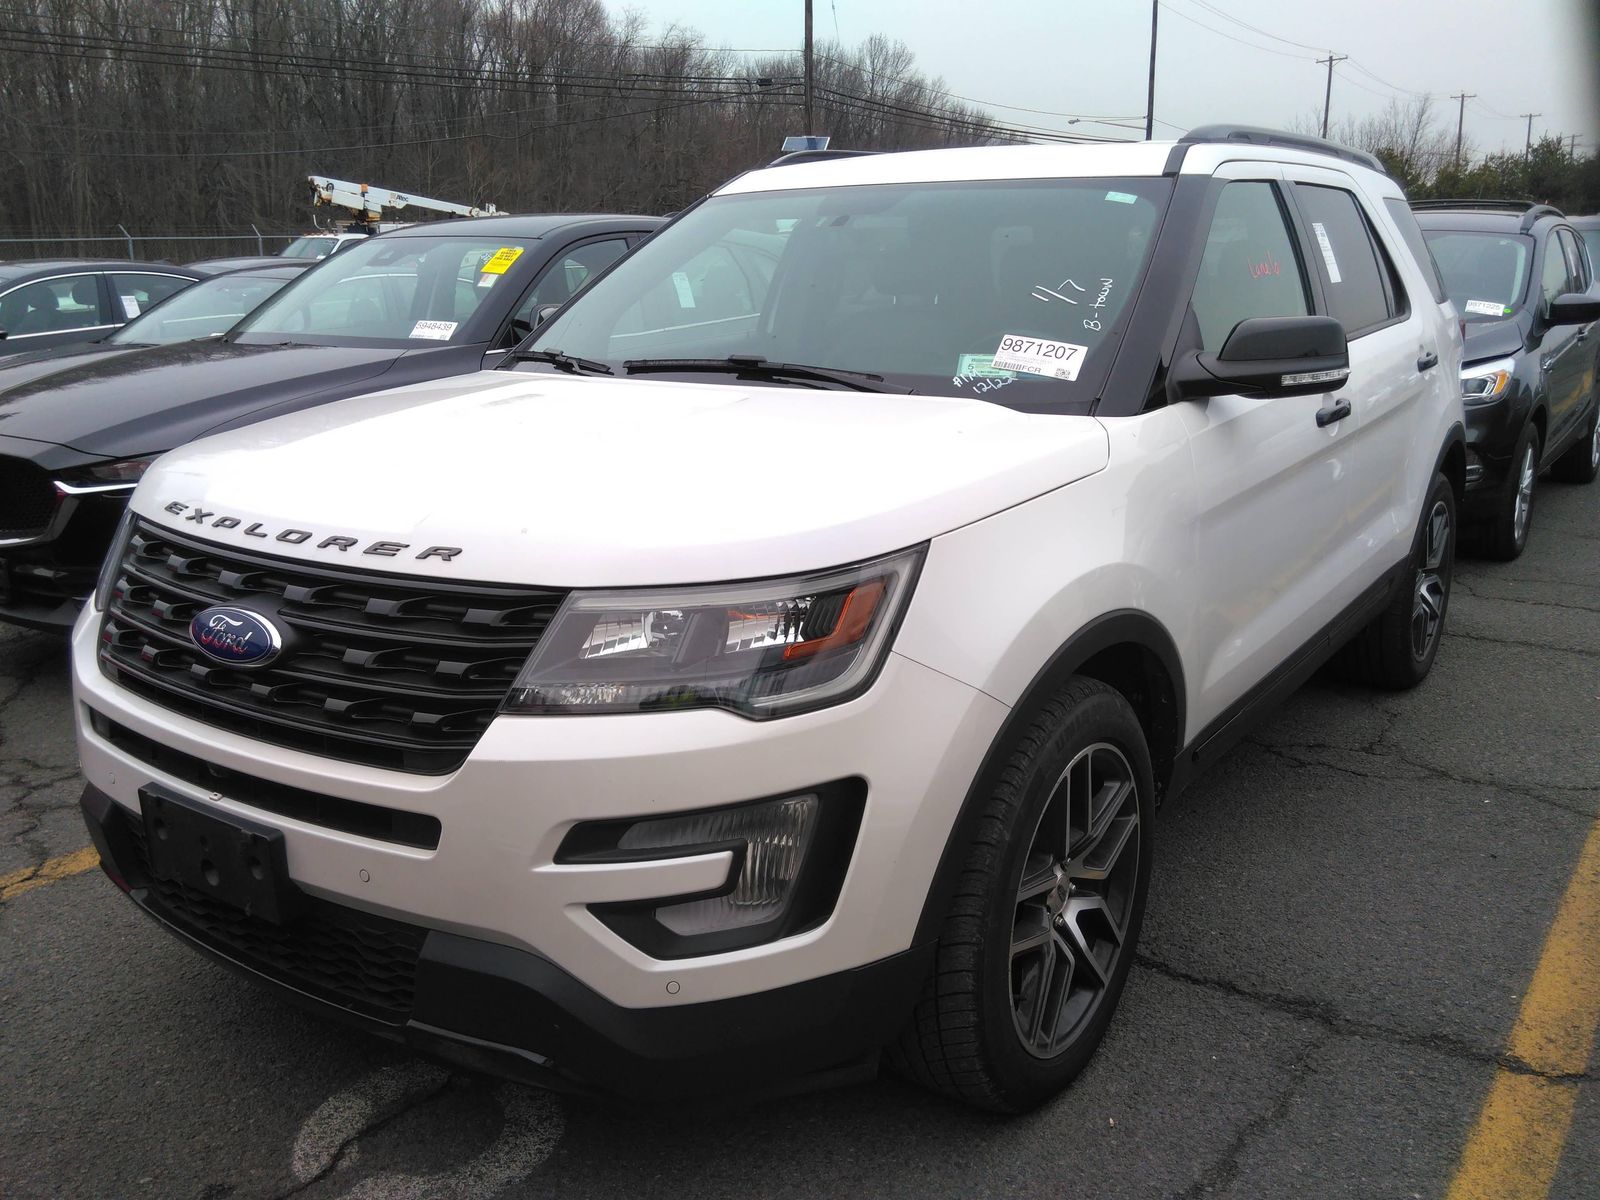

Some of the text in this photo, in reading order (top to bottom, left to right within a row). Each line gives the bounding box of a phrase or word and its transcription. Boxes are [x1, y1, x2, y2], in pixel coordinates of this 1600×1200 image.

[1001, 338, 1078, 361] 9871207
[1022, 365, 1042, 374] FCR
[164, 500, 463, 562] EXPLORER
[201, 614, 254, 655] Ford
